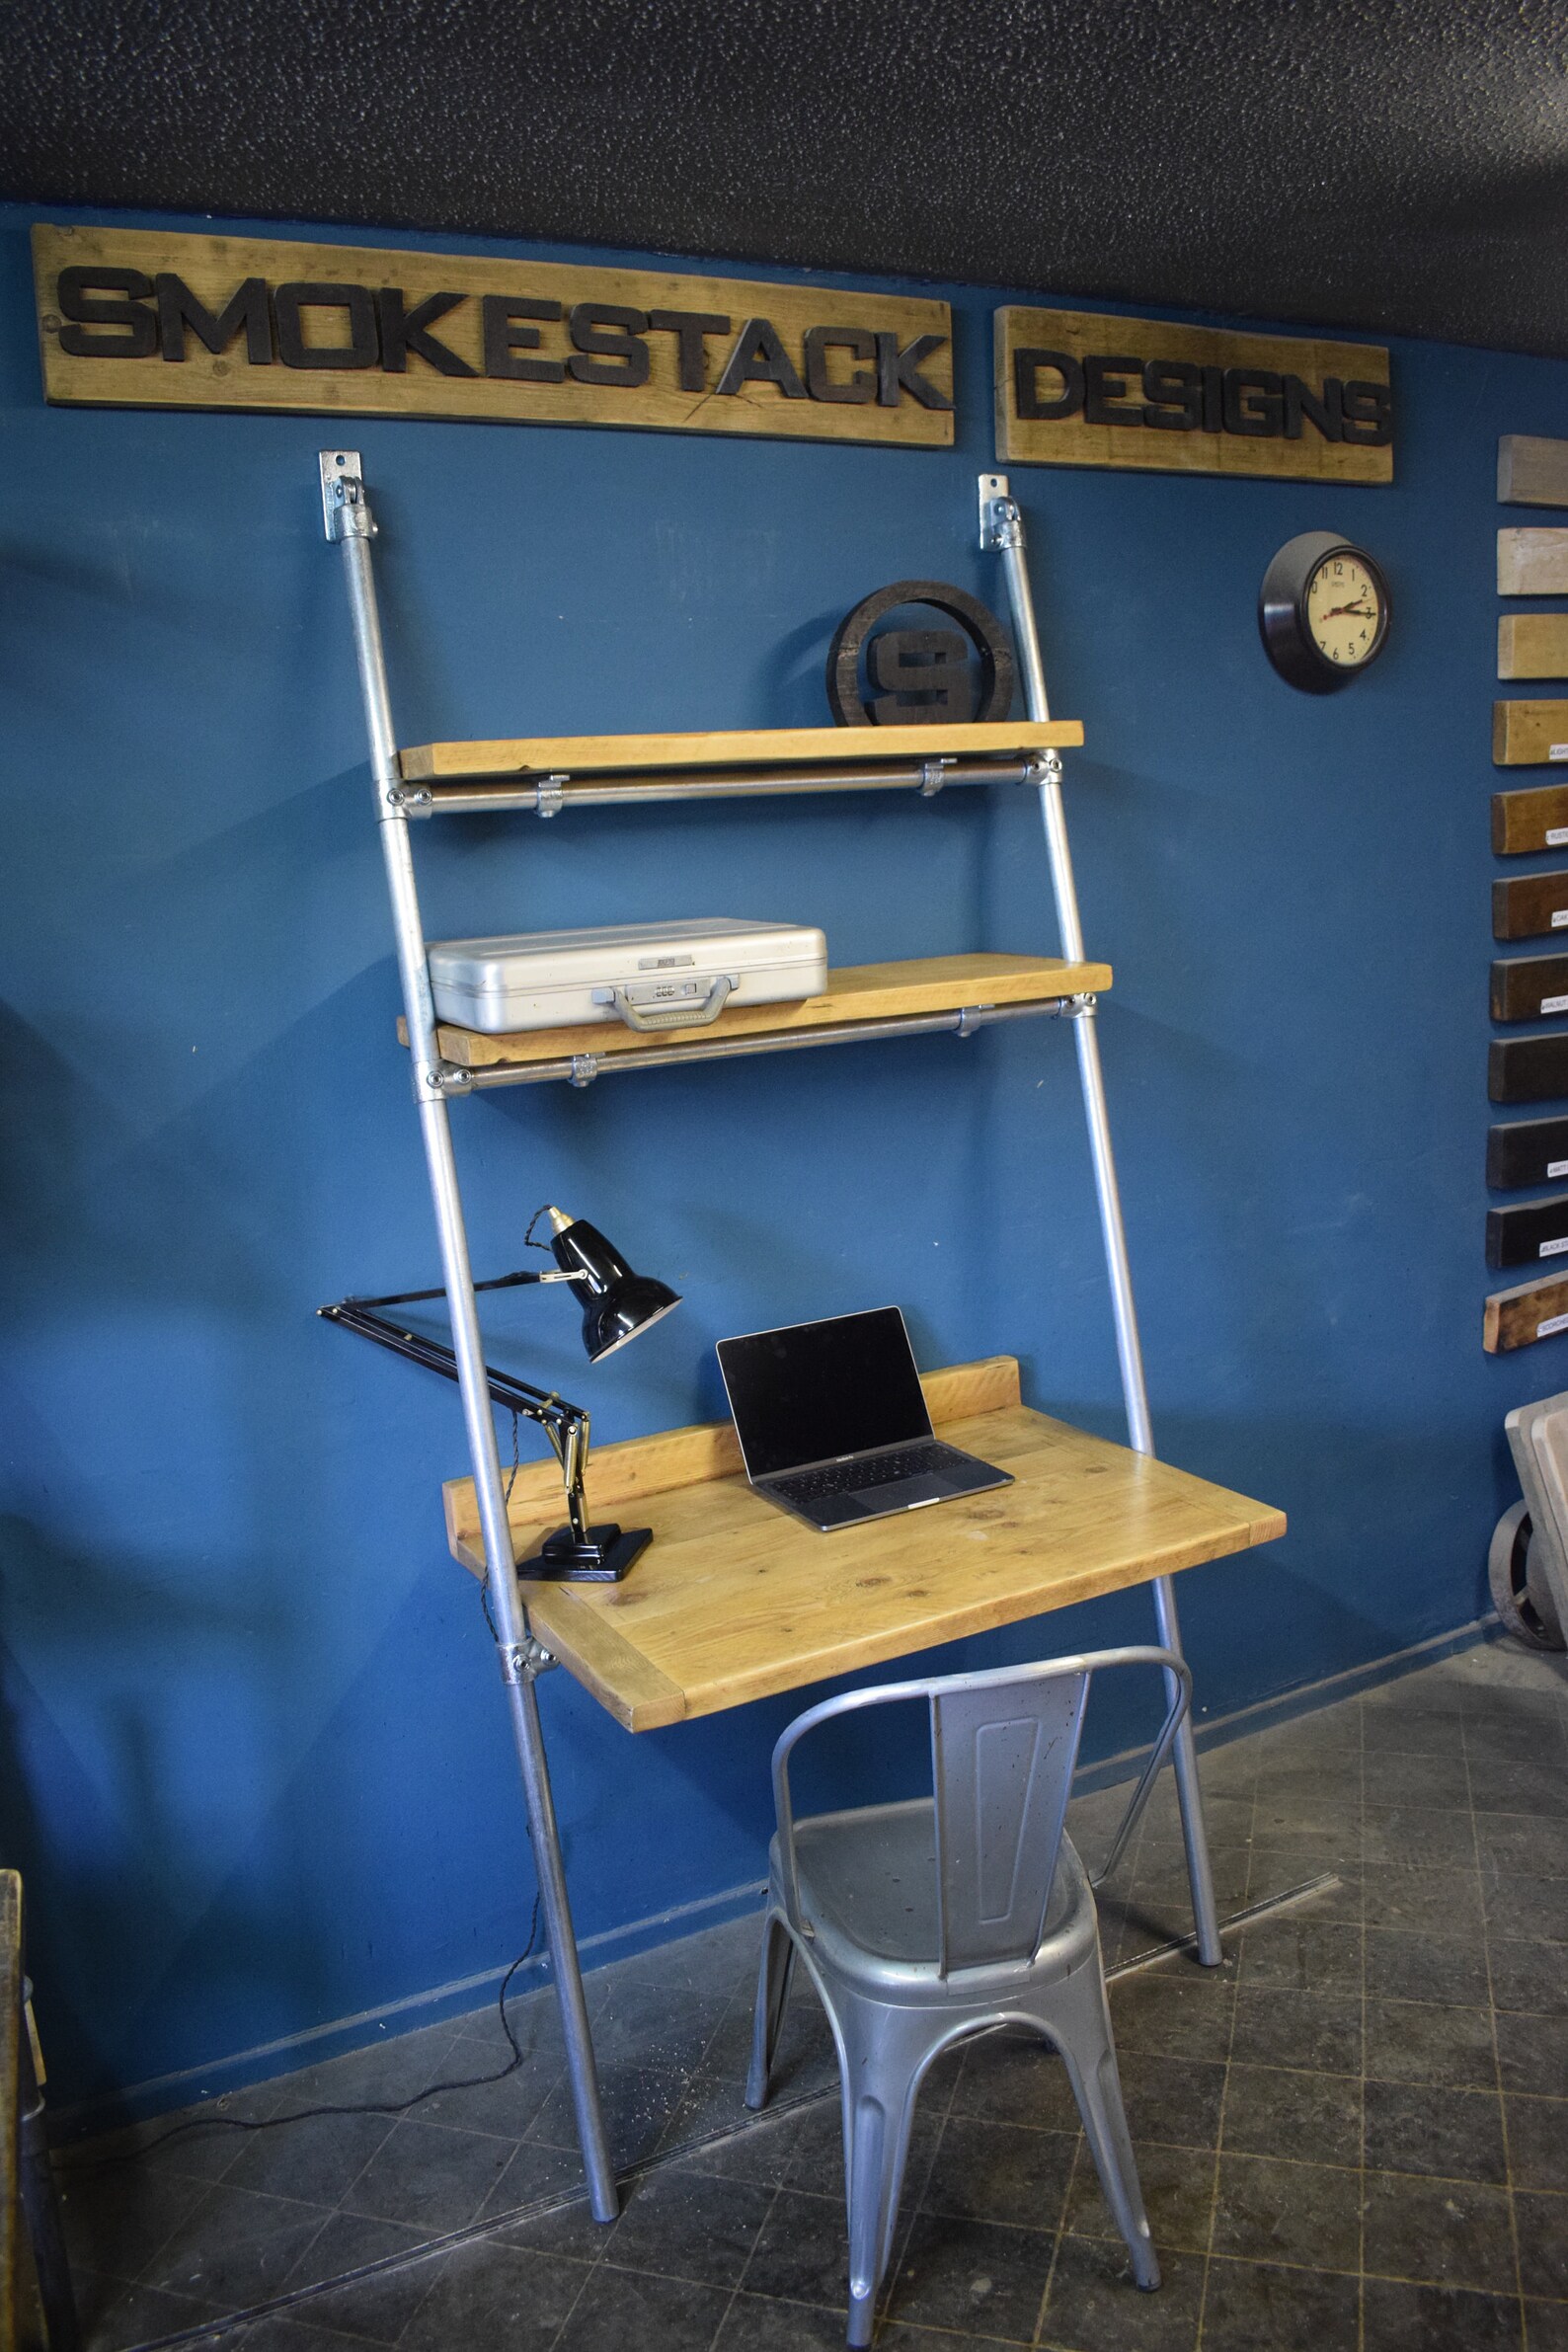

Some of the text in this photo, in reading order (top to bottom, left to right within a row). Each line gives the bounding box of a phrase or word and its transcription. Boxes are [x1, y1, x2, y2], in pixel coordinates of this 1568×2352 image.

[56, 266, 957, 411] SMOKESTACK
[1013, 348, 1393, 447] DESIGNS
[1321, 567, 1328, 580] 11
[1334, 562, 1343, 576] 12
[1352, 569, 1355, 582] 1
[1312, 581, 1317, 593] 0
[1361, 585, 1367, 596] 2
[1360, 629, 1367, 640] 4
[1320, 641, 1327, 653] 7
[1348, 643, 1355, 656] 5
[1333, 648, 1339, 661] 6
